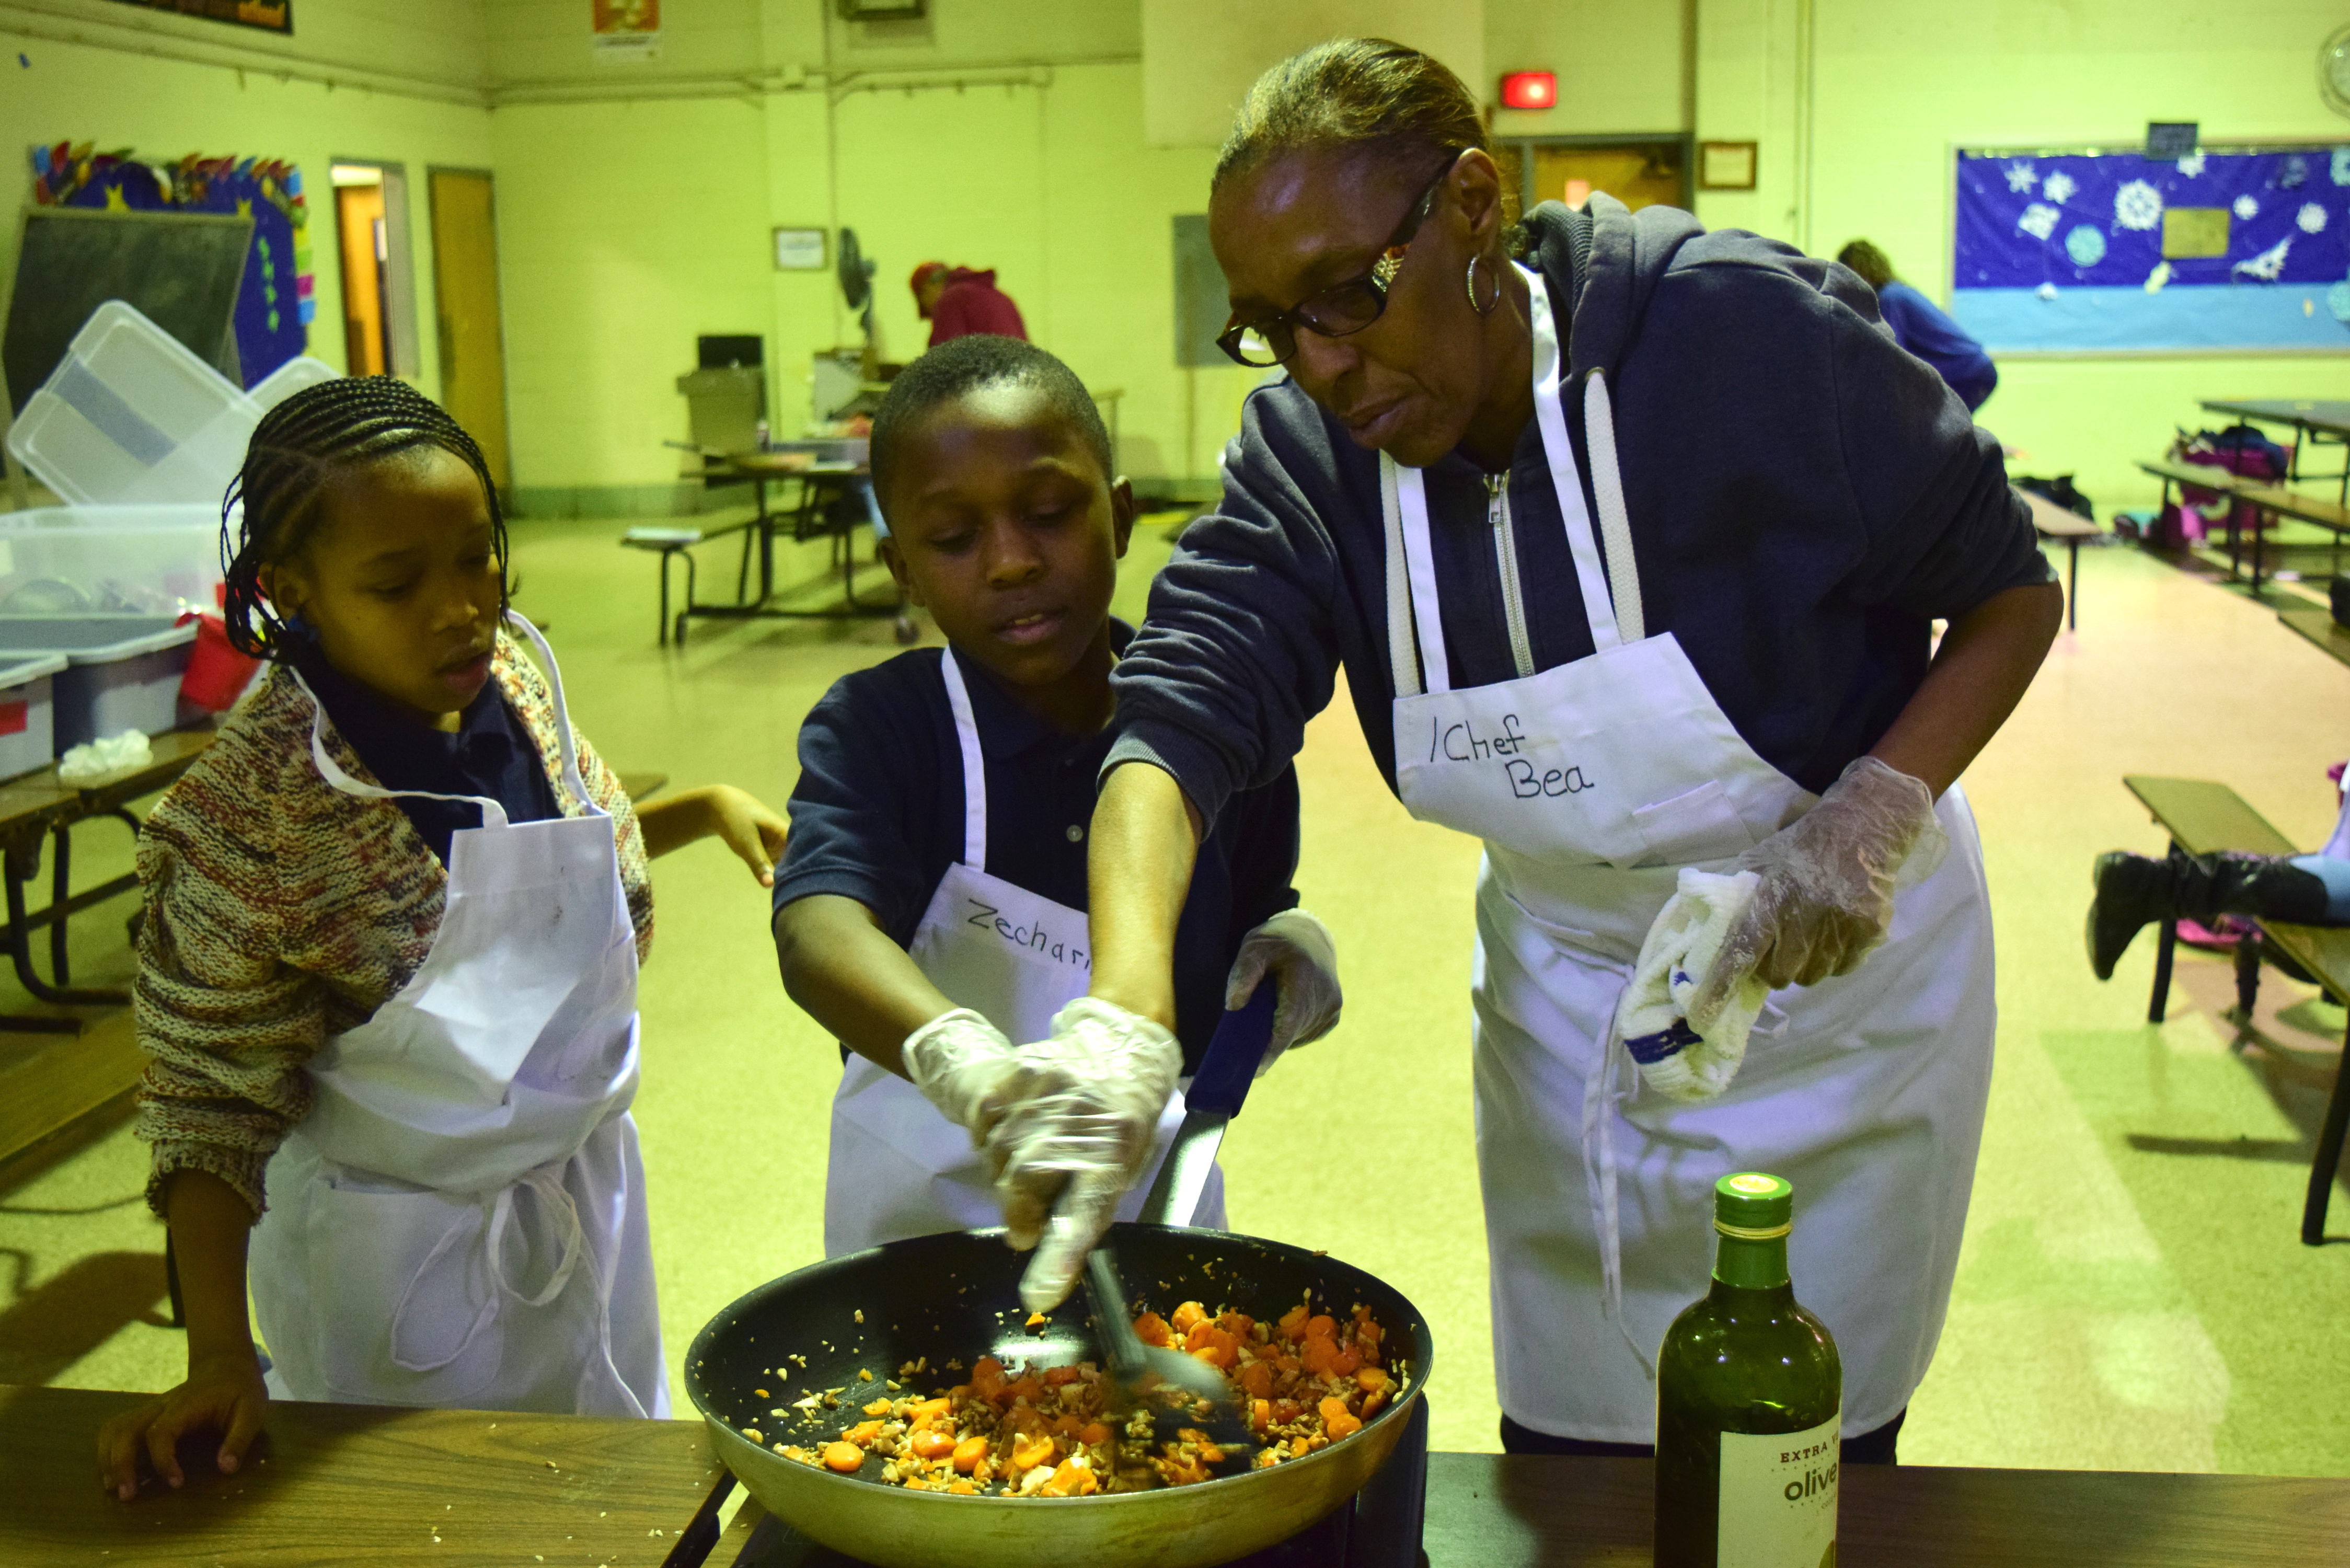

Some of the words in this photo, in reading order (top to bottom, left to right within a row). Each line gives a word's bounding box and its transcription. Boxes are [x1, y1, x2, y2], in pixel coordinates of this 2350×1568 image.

[1505, 759, 1595, 799] Bea
[1780, 1441, 1828, 1463] EXTRA
[1784, 1462, 1837, 1501] olive
